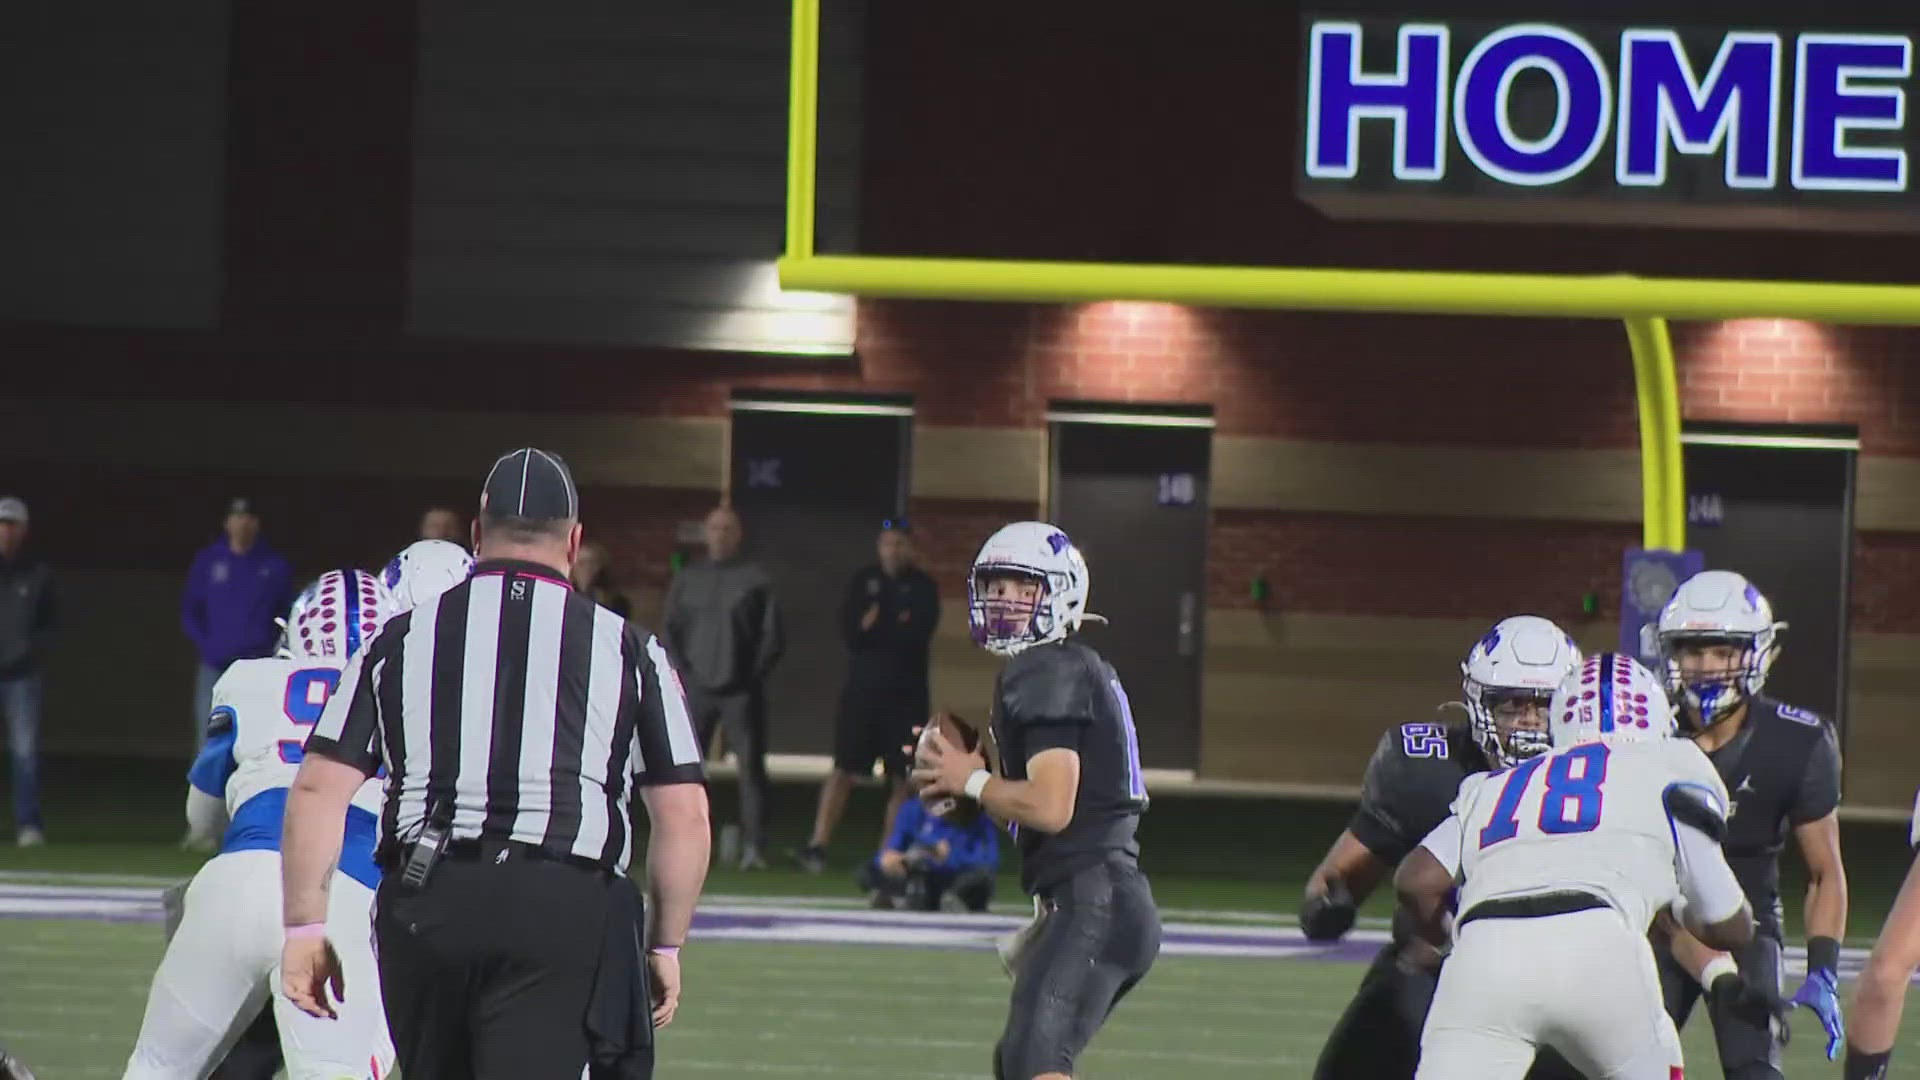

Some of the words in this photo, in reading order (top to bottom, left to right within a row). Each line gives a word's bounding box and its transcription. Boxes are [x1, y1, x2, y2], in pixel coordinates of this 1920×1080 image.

[1306, 22, 1912, 191] HOME
[321, 638, 336, 656] 15
[278, 667, 342, 763] 9
[1400, 721, 1449, 760] 65
[1578, 706, 1593, 723] 15
[1479, 741, 1611, 850] 78
